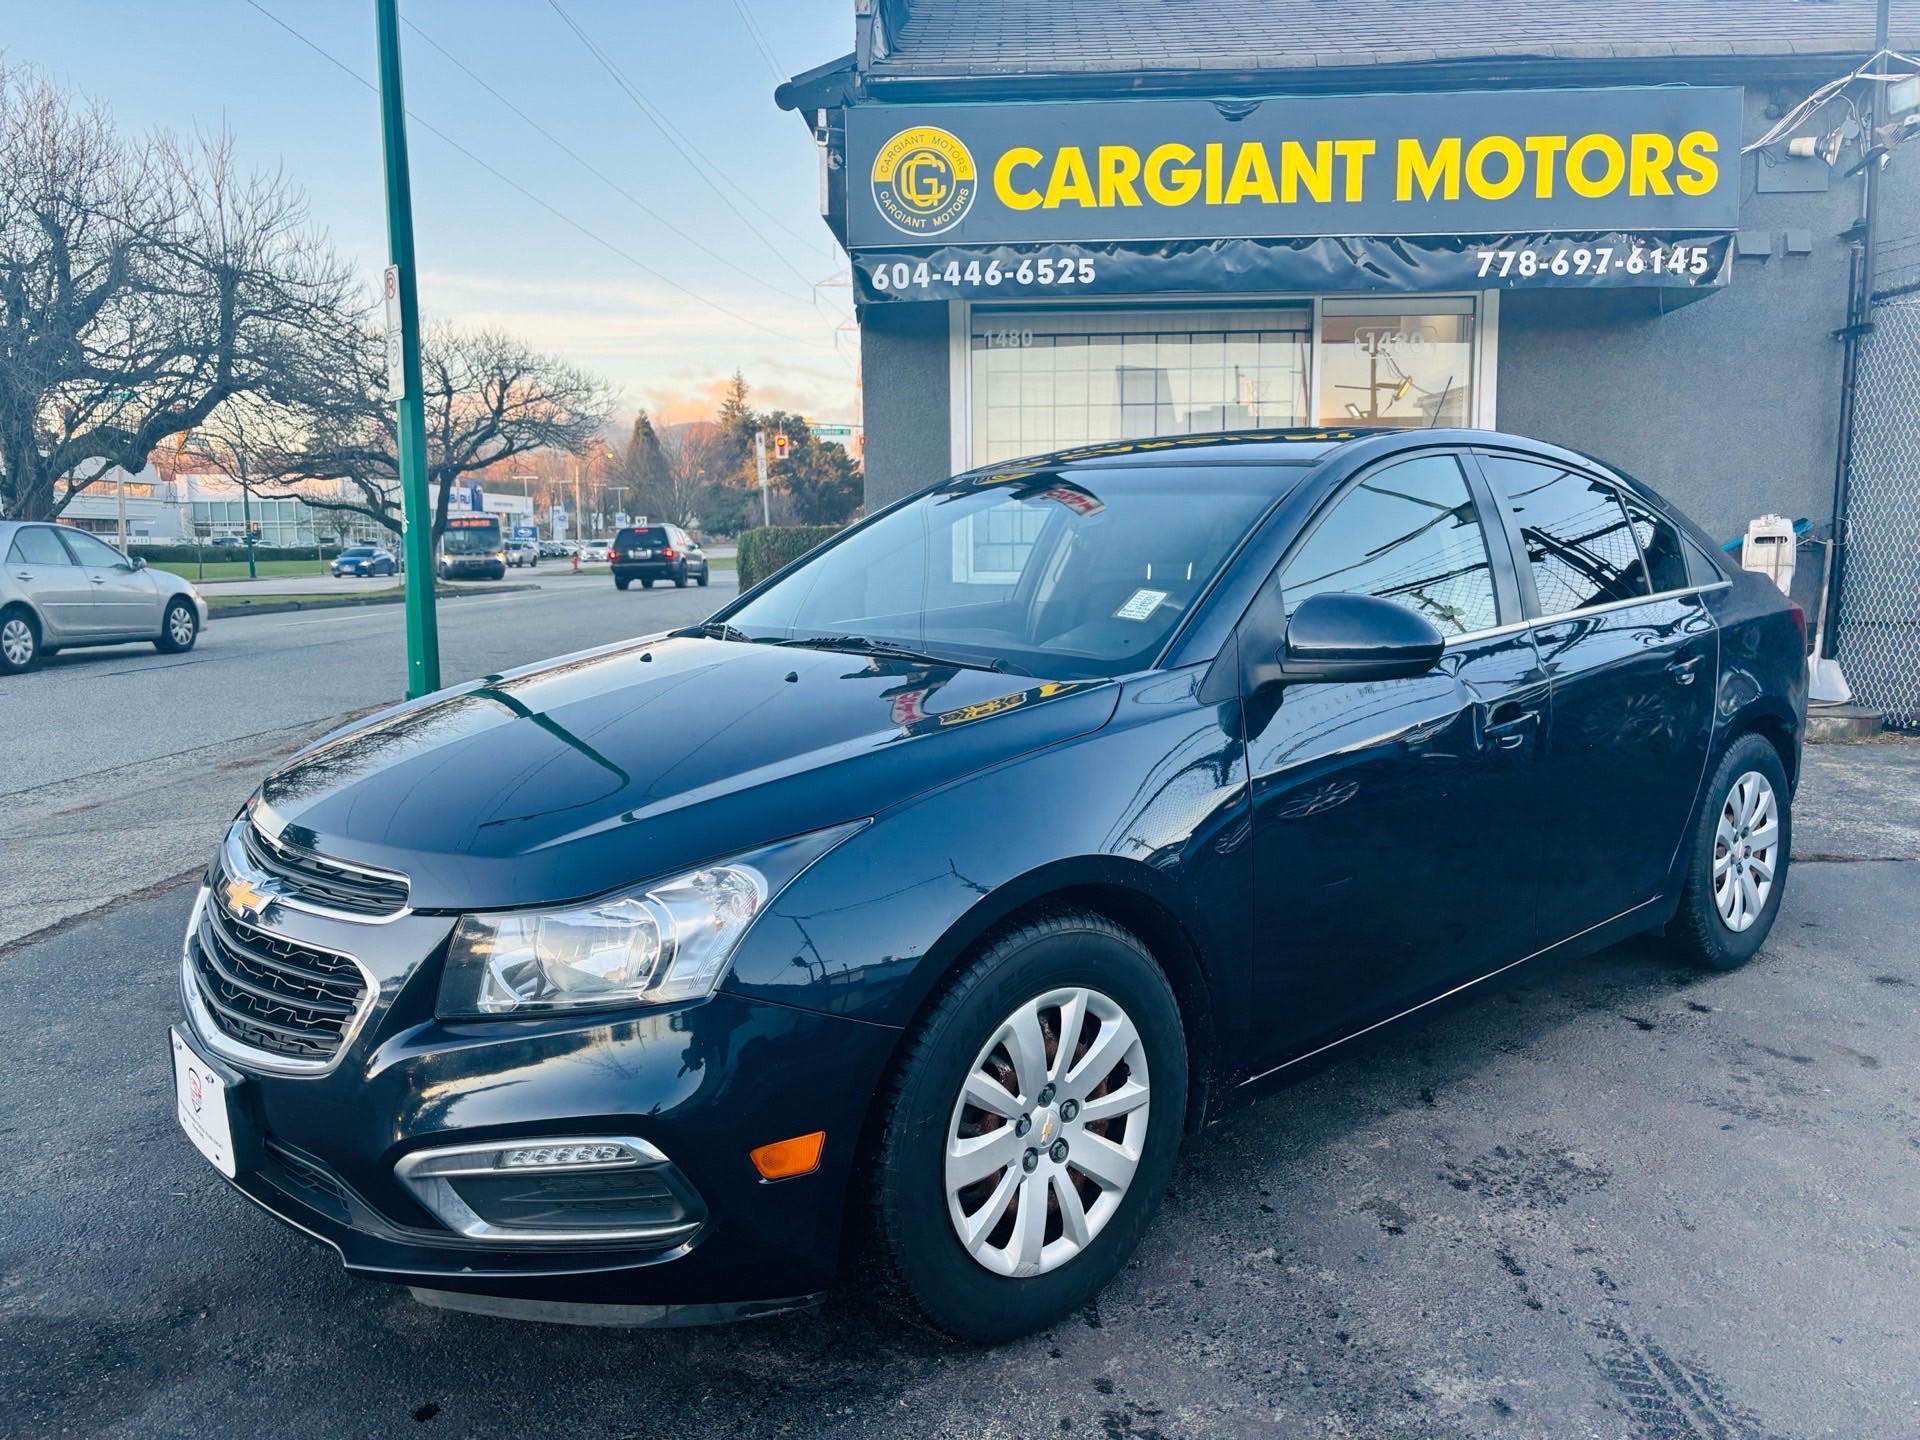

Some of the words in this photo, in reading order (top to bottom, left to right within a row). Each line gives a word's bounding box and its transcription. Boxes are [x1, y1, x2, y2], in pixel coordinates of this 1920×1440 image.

[880, 134, 925, 173] CARGIANT
[931, 135, 968, 173] MOTORS
[993, 139, 1376, 210] CARGIANT
[1396, 131, 1719, 202] MOTORS
[880, 191, 927, 228] CARGIANT
[932, 188, 969, 227] MOTORS
[871, 258, 1096, 290] 604-446-6525
[1477, 248, 1708, 277] 778-697-6145
[984, 329, 1033, 347] 1480
[1365, 331, 1424, 353] 1480
